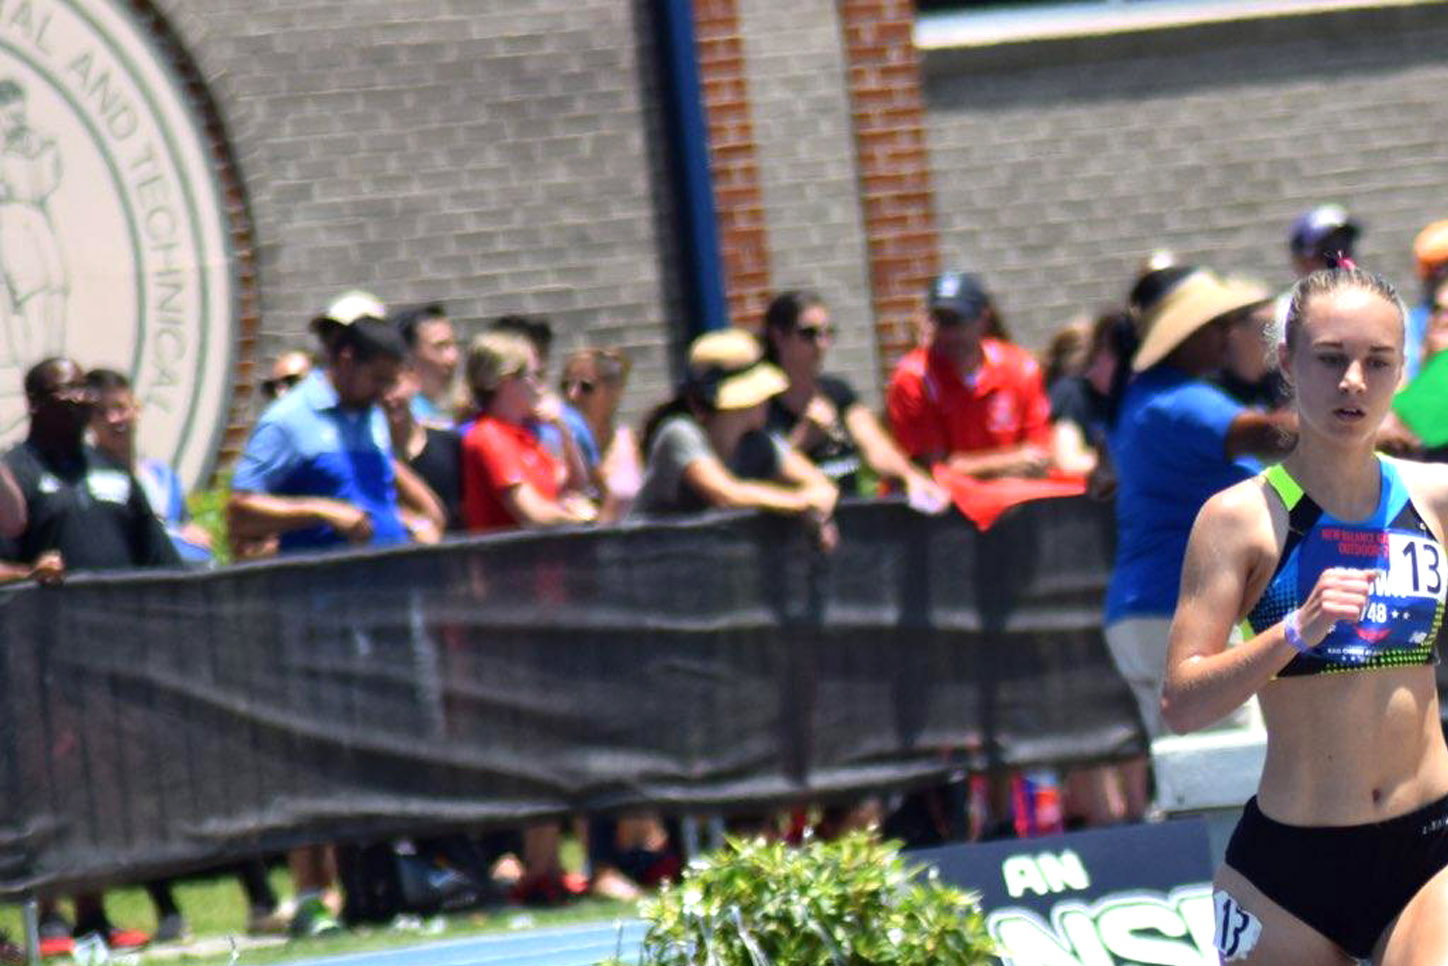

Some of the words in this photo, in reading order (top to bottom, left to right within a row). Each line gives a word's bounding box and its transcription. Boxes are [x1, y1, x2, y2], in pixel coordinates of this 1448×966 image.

[67, 47, 141, 143] AND
[129, 141, 188, 414] TECHNICAL
[1401, 540, 1442, 595] 13
[1002, 849, 1091, 898] AN
[1220, 898, 1251, 958] 13
